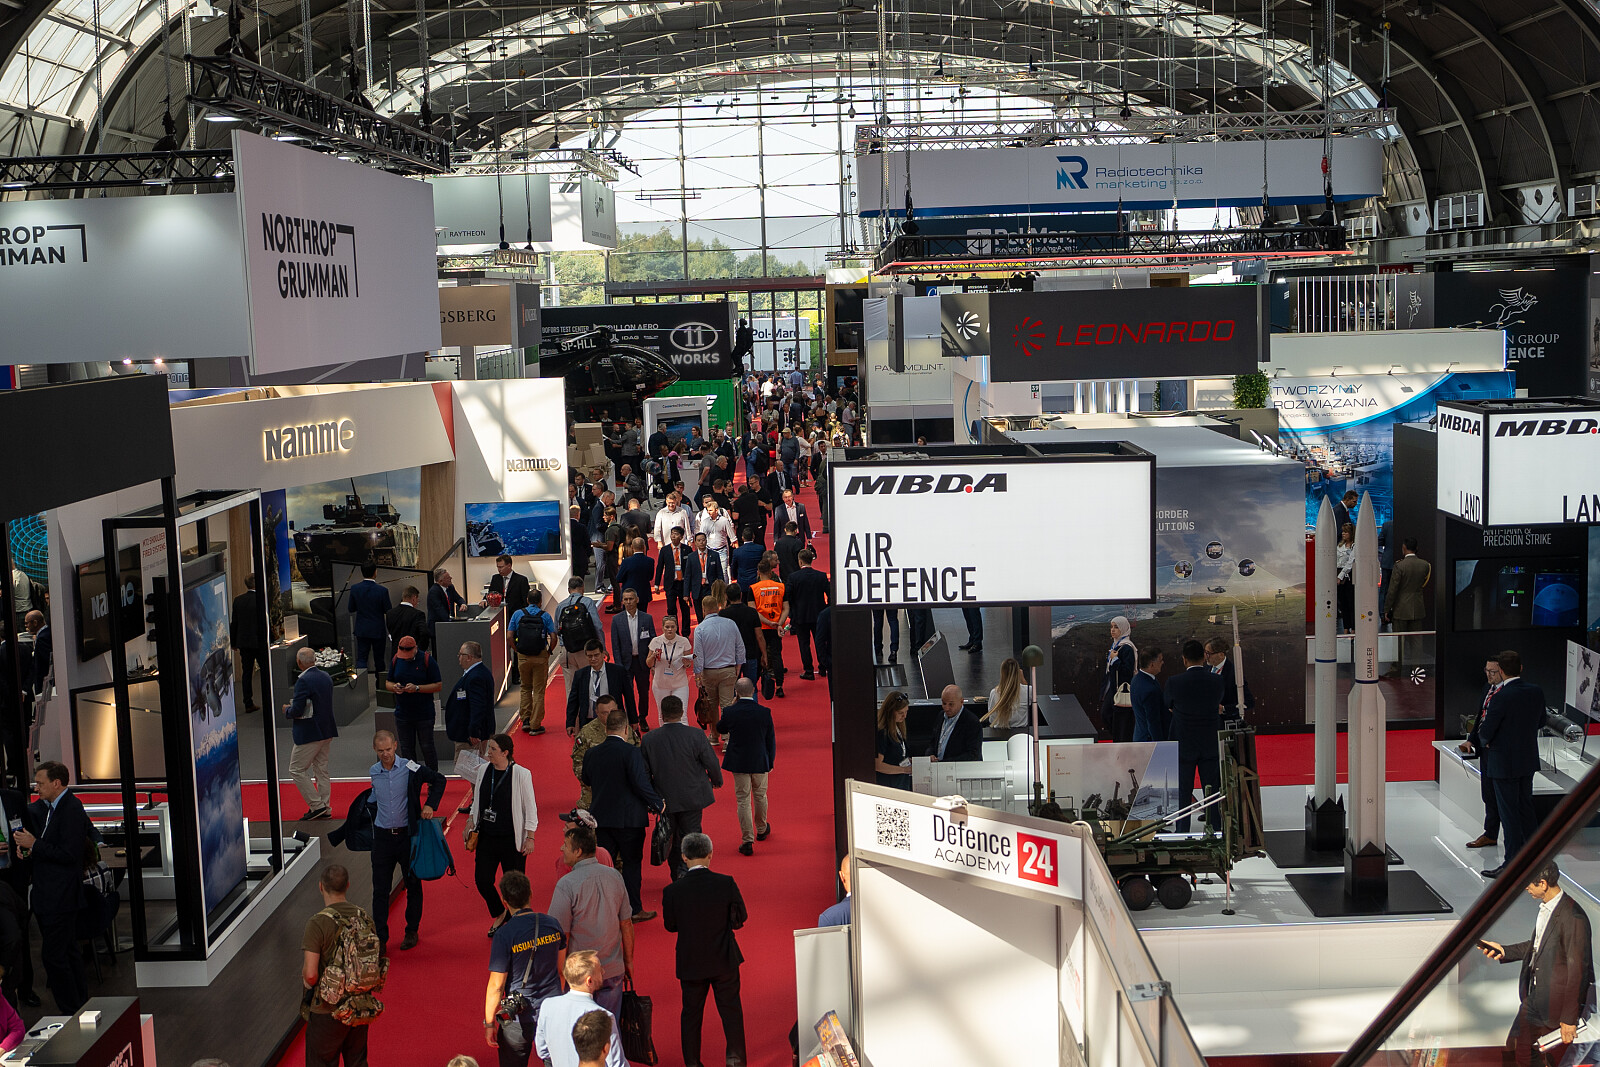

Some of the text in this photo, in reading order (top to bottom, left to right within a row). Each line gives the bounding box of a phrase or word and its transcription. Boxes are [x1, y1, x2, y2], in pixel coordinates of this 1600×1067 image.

[1095, 165, 1204, 178] Radiotechnika
[1095, 178, 1167, 189] marketing
[262, 212, 336, 257] NORTHROP
[449, 230, 486, 238] RAYTHEON
[277, 259, 349, 299] GRUMMAN
[560, 338, 597, 352] SP-HLL
[1056, 320, 1236, 347] LEONARDO
[1518, 333, 1560, 345] GROUP
[670, 352, 720, 365] WORKS
[1506, 346, 1545, 359] ENCE
[1272, 384, 1364, 396] TWORZYMY
[1273, 397, 1379, 411] ROZWIĄZANIA
[1439, 413, 1481, 437] MBDA
[844, 473, 1008, 496] MBDA
[1460, 490, 1481, 524] LAND
[844, 532, 893, 569] AIR
[1483, 533, 1552, 547] PRECISION STRIKE
[846, 566, 977, 604] DEFENCE
[933, 814, 1011, 857] Defence
[934, 847, 1010, 875] ACADEMY
[1022, 841, 1053, 878] 24
